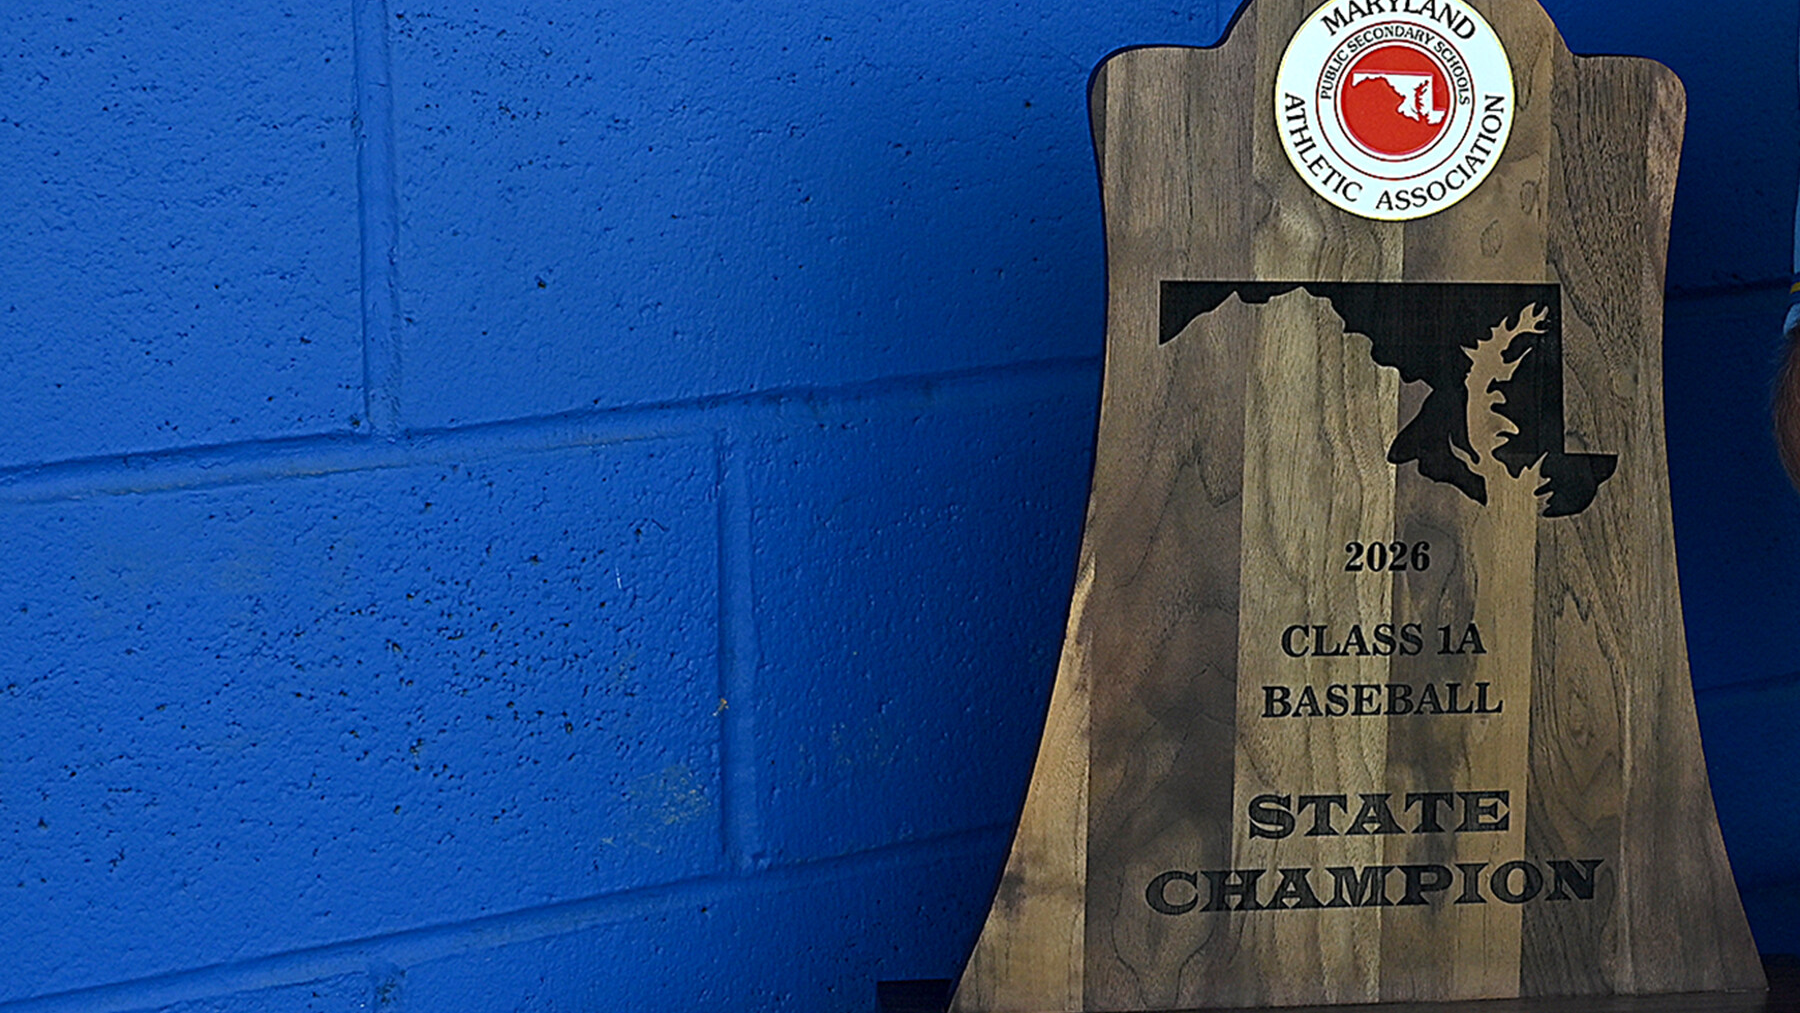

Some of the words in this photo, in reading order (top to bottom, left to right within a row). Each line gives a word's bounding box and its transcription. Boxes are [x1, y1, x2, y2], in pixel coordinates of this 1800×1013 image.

[1320, 49, 1350, 100] PUBLIC
[1347, 25, 1436, 54] SECONDARY
[1433, 41, 1471, 105] SCHOOLS
[1284, 92, 1363, 202] ATHLETIC
[1375, 94, 1505, 211] ASSOCIATION
[1344, 541, 1430, 572] 2026
[1281, 624, 1424, 657] CLASS
[1437, 624, 1487, 655] 1A
[1262, 682, 1504, 717] BASEBALL
[1248, 790, 1511, 839] STATE
[1145, 859, 1605, 916] CHAMPION
